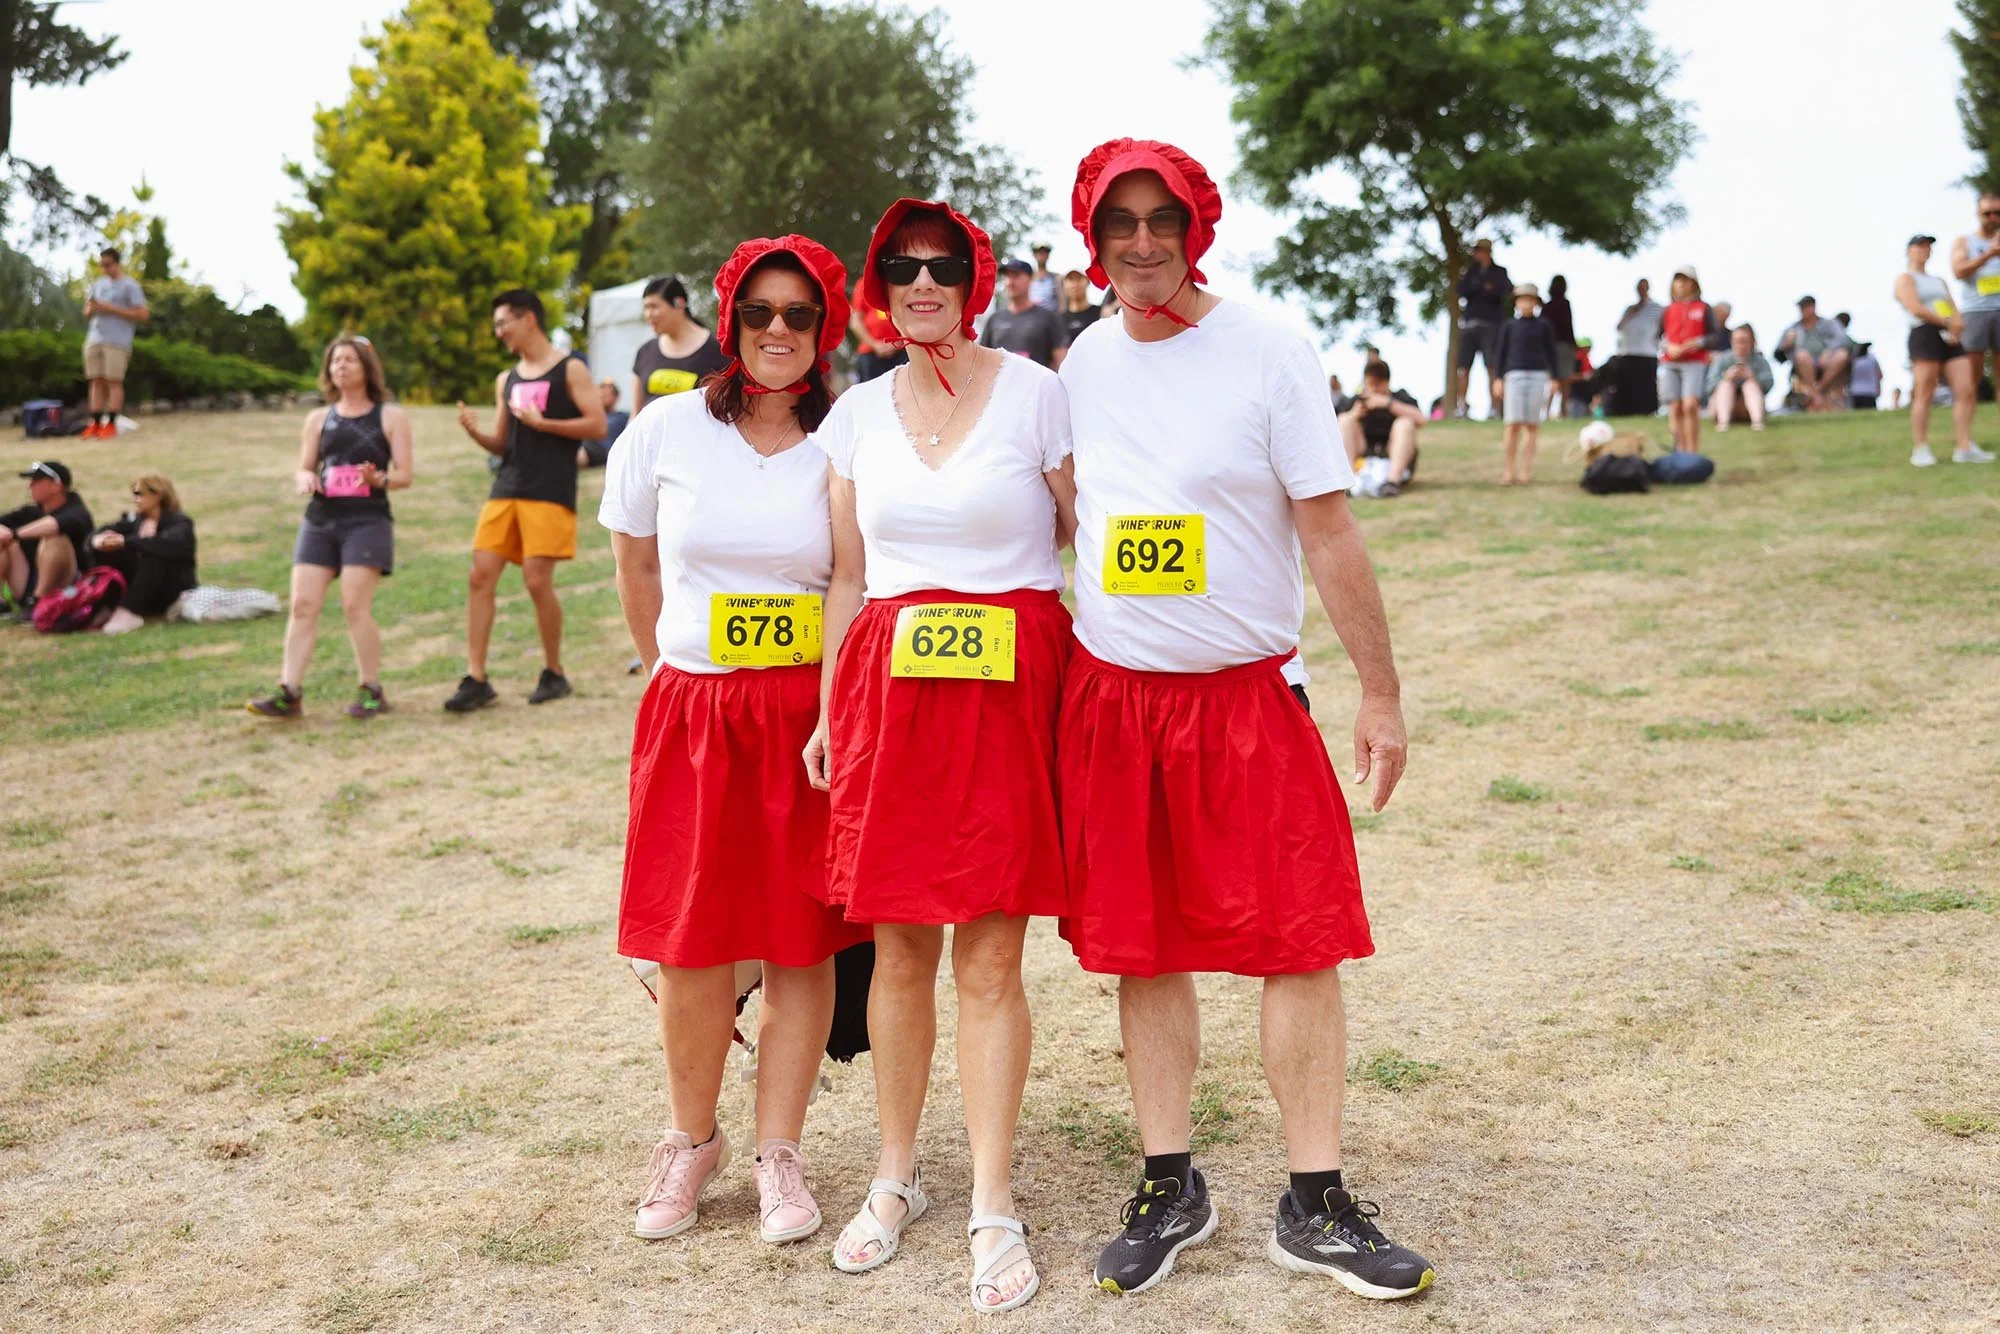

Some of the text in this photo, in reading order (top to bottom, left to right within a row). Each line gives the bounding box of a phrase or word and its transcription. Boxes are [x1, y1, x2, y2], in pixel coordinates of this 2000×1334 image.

[1119, 519, 1181, 530] VINE RUN
[1116, 538, 1185, 573] 692
[729, 598, 792, 608] VINE RUN
[916, 607, 982, 619] VINE RUN
[726, 615, 794, 647] 678
[911, 624, 984, 659] 628
